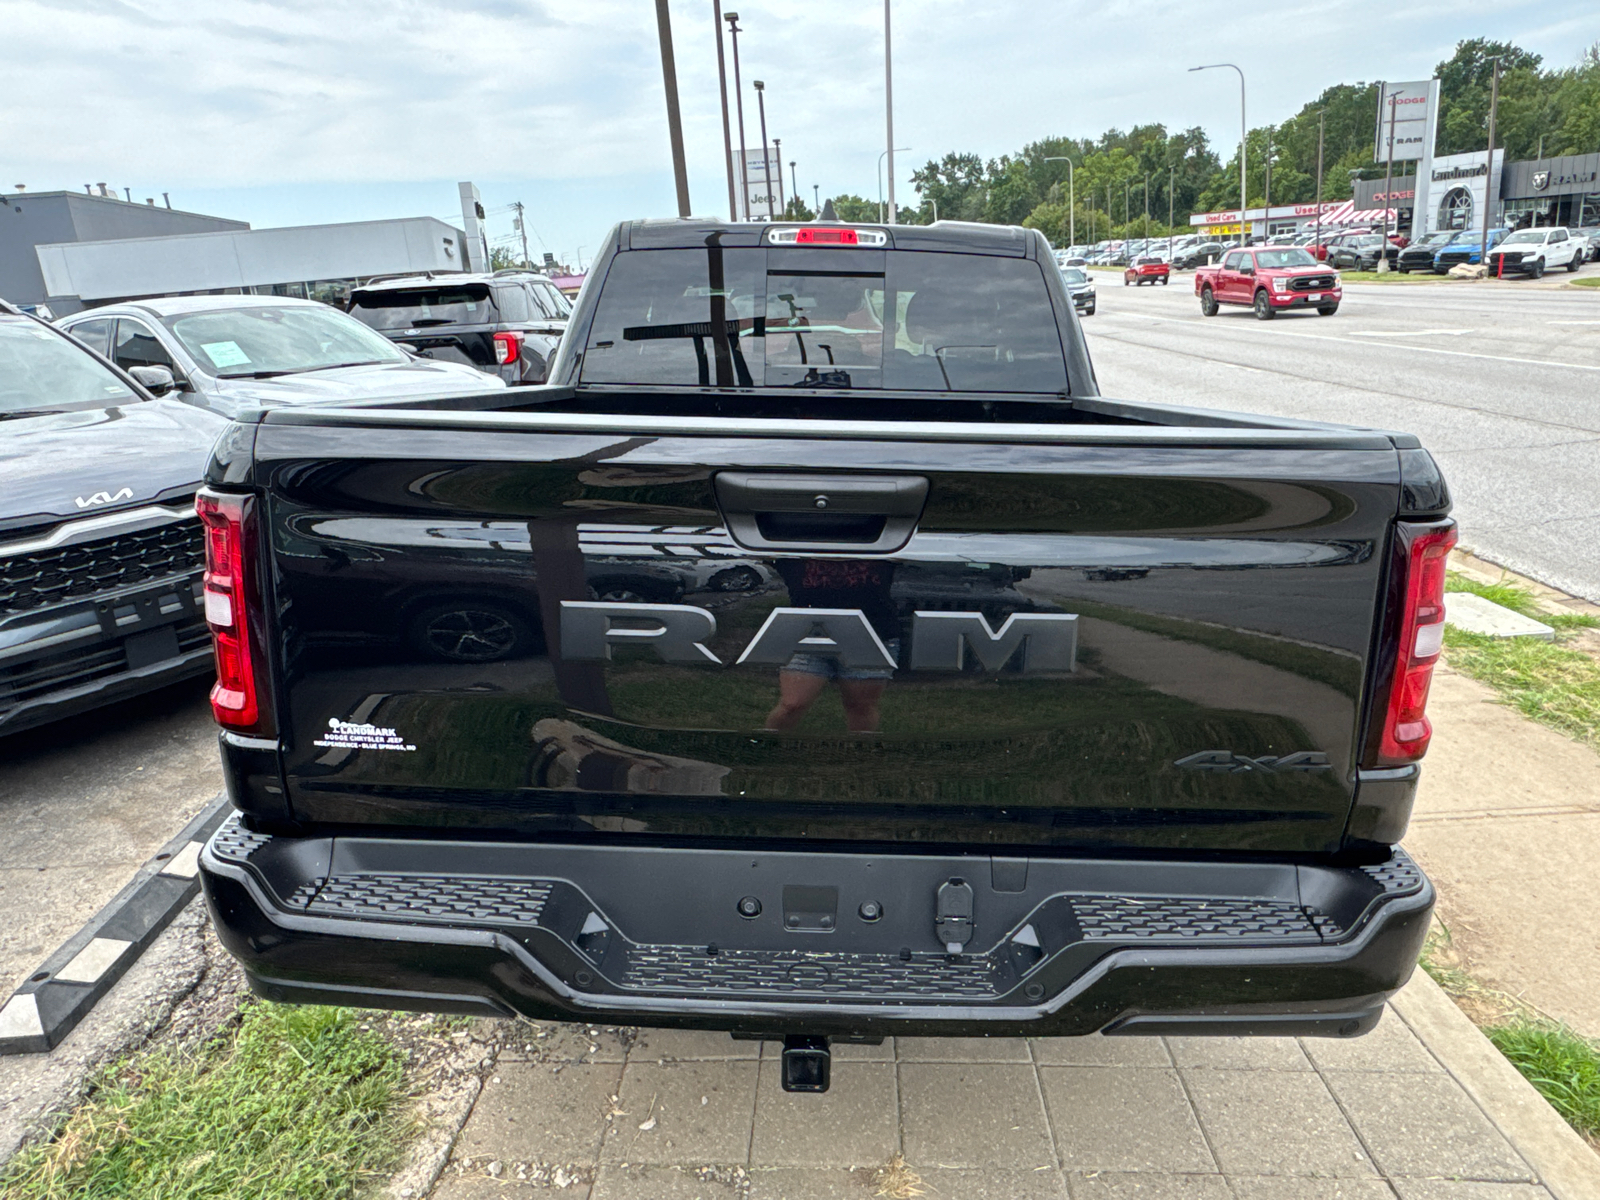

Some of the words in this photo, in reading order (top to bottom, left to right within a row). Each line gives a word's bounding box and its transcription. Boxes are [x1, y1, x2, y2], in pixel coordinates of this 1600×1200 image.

[1431, 163, 1488, 182] Landmark
[1552, 172, 1596, 185] RAM
[1206, 214, 1220, 222] Used
[1221, 213, 1236, 221] Cars
[560, 600, 1080, 672] RAM
[340, 726, 396, 737] LANDMARK
[324, 733, 348, 741] DODGE
[349, 734, 385, 743] CHRYSLER
[386, 736, 404, 744] JEEP
[313, 740, 358, 749] INDEPENDENCE
